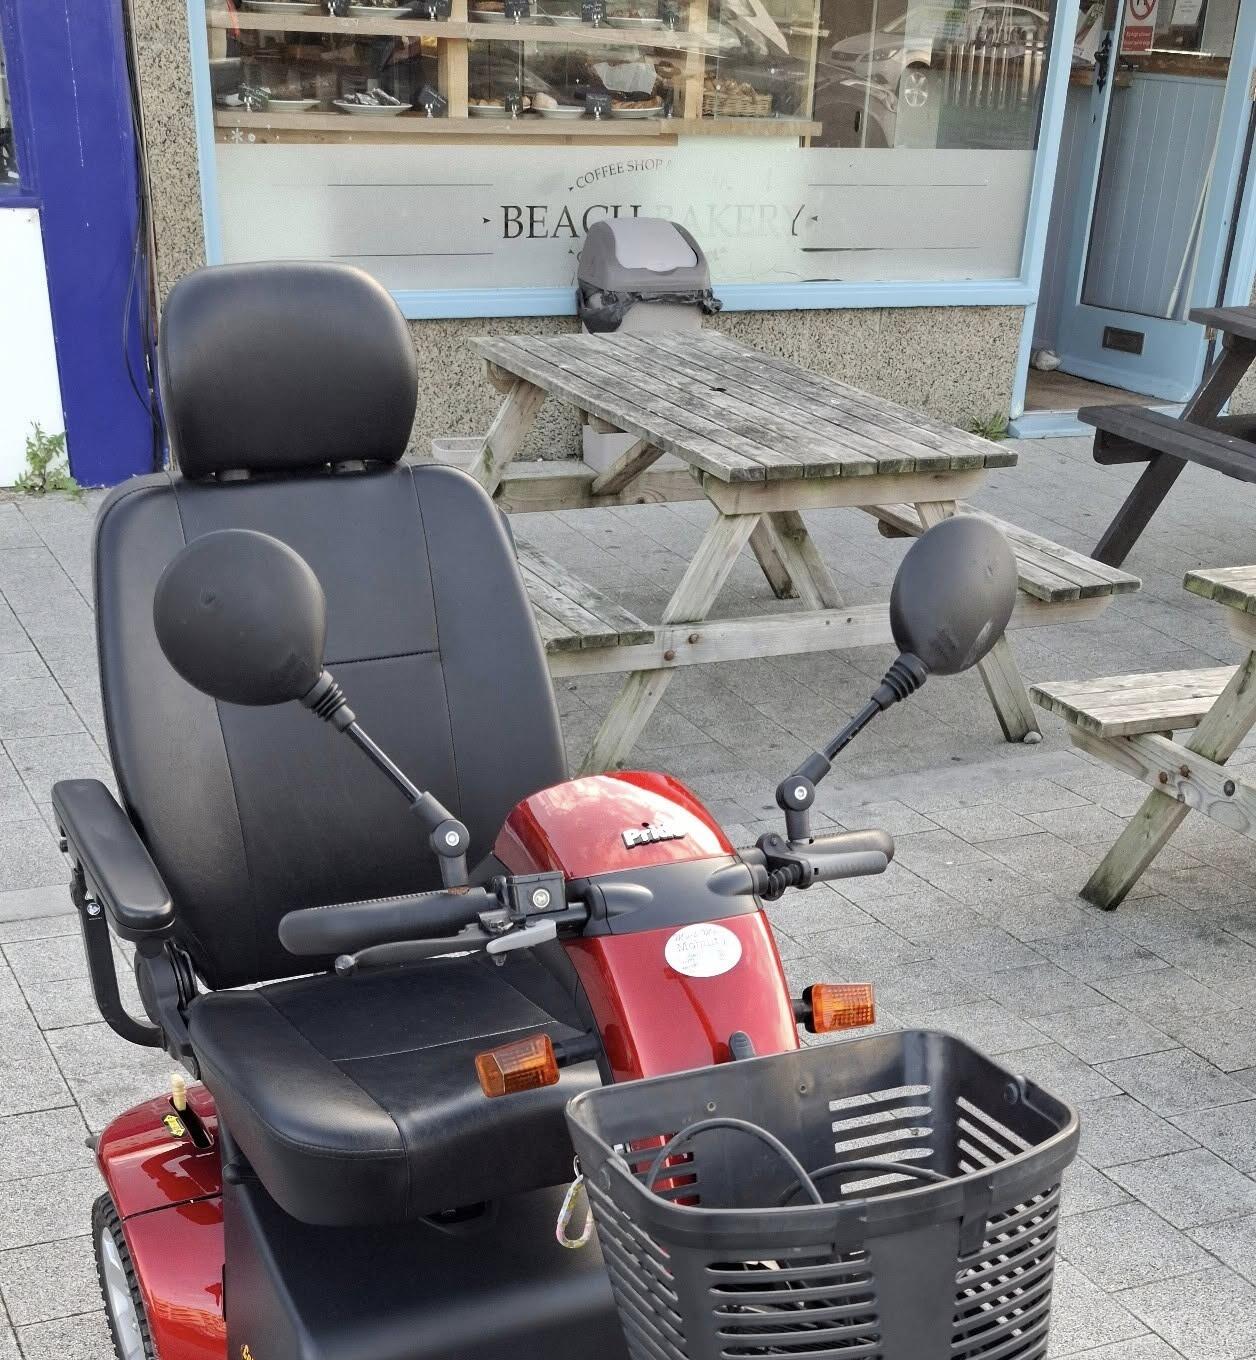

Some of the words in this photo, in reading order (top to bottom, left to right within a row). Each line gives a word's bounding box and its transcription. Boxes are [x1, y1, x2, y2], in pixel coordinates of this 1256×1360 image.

[575, 161, 625, 189] COFFEE
[626, 158, 664, 173] SHOP
[621, 823, 687, 849] Prid
